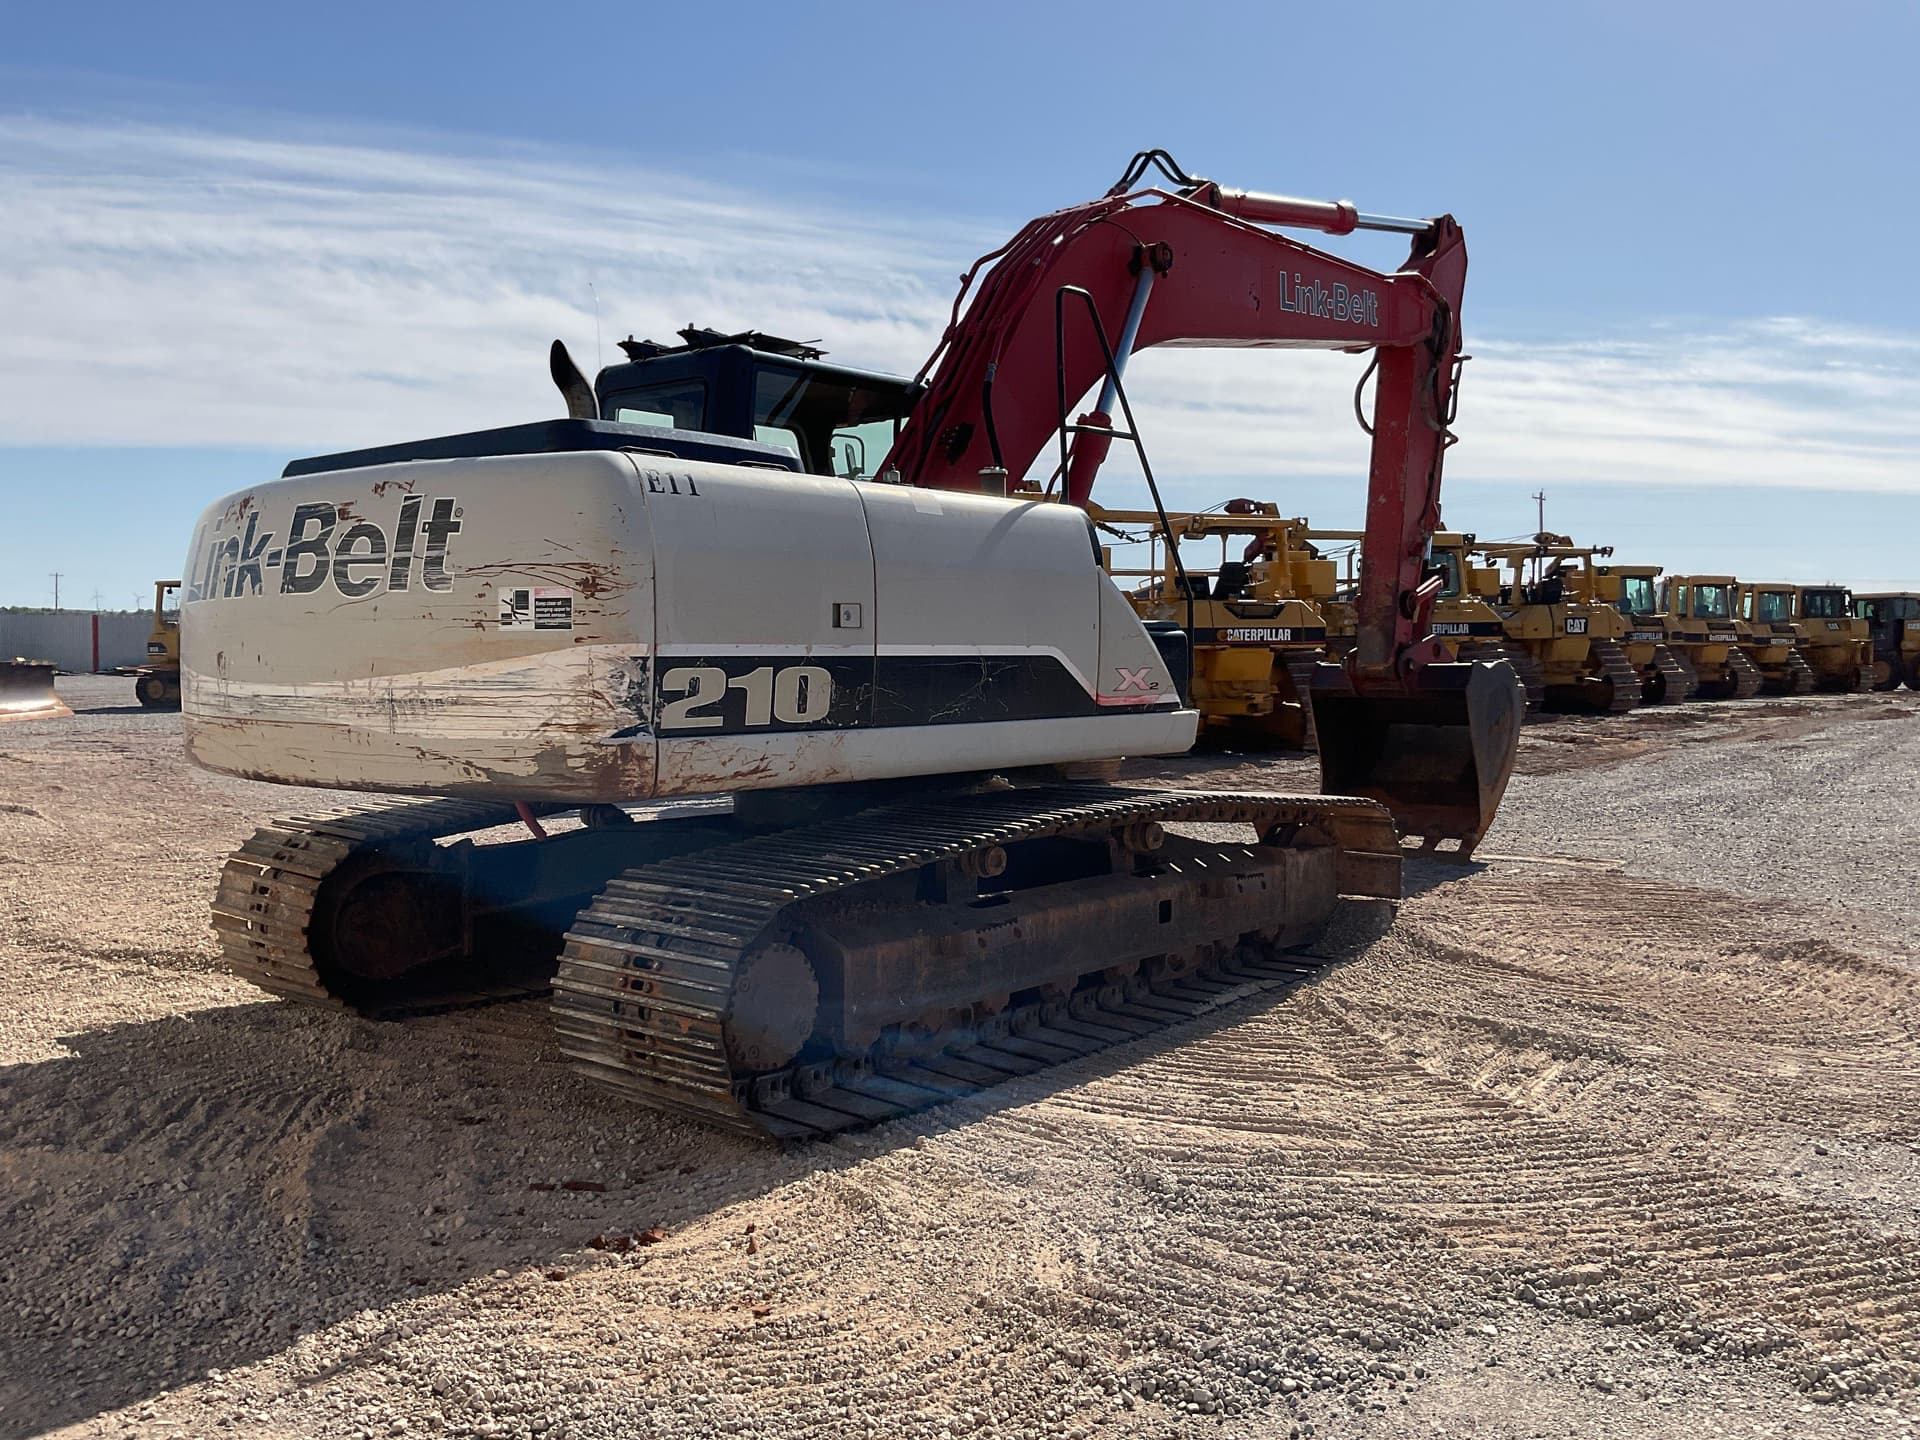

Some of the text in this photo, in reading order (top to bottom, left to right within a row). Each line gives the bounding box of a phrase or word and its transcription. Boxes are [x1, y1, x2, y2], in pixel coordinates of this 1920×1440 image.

[1280, 271, 1378, 327] Link-Belt
[643, 468, 701, 497] E11
[187, 494, 463, 604] Link-Belt
[1227, 628, 1291, 641] CATERPILLAR
[1432, 623, 1470, 634] ERPILLAR
[1567, 619, 1586, 633] CAT
[660, 666, 832, 730] 210
